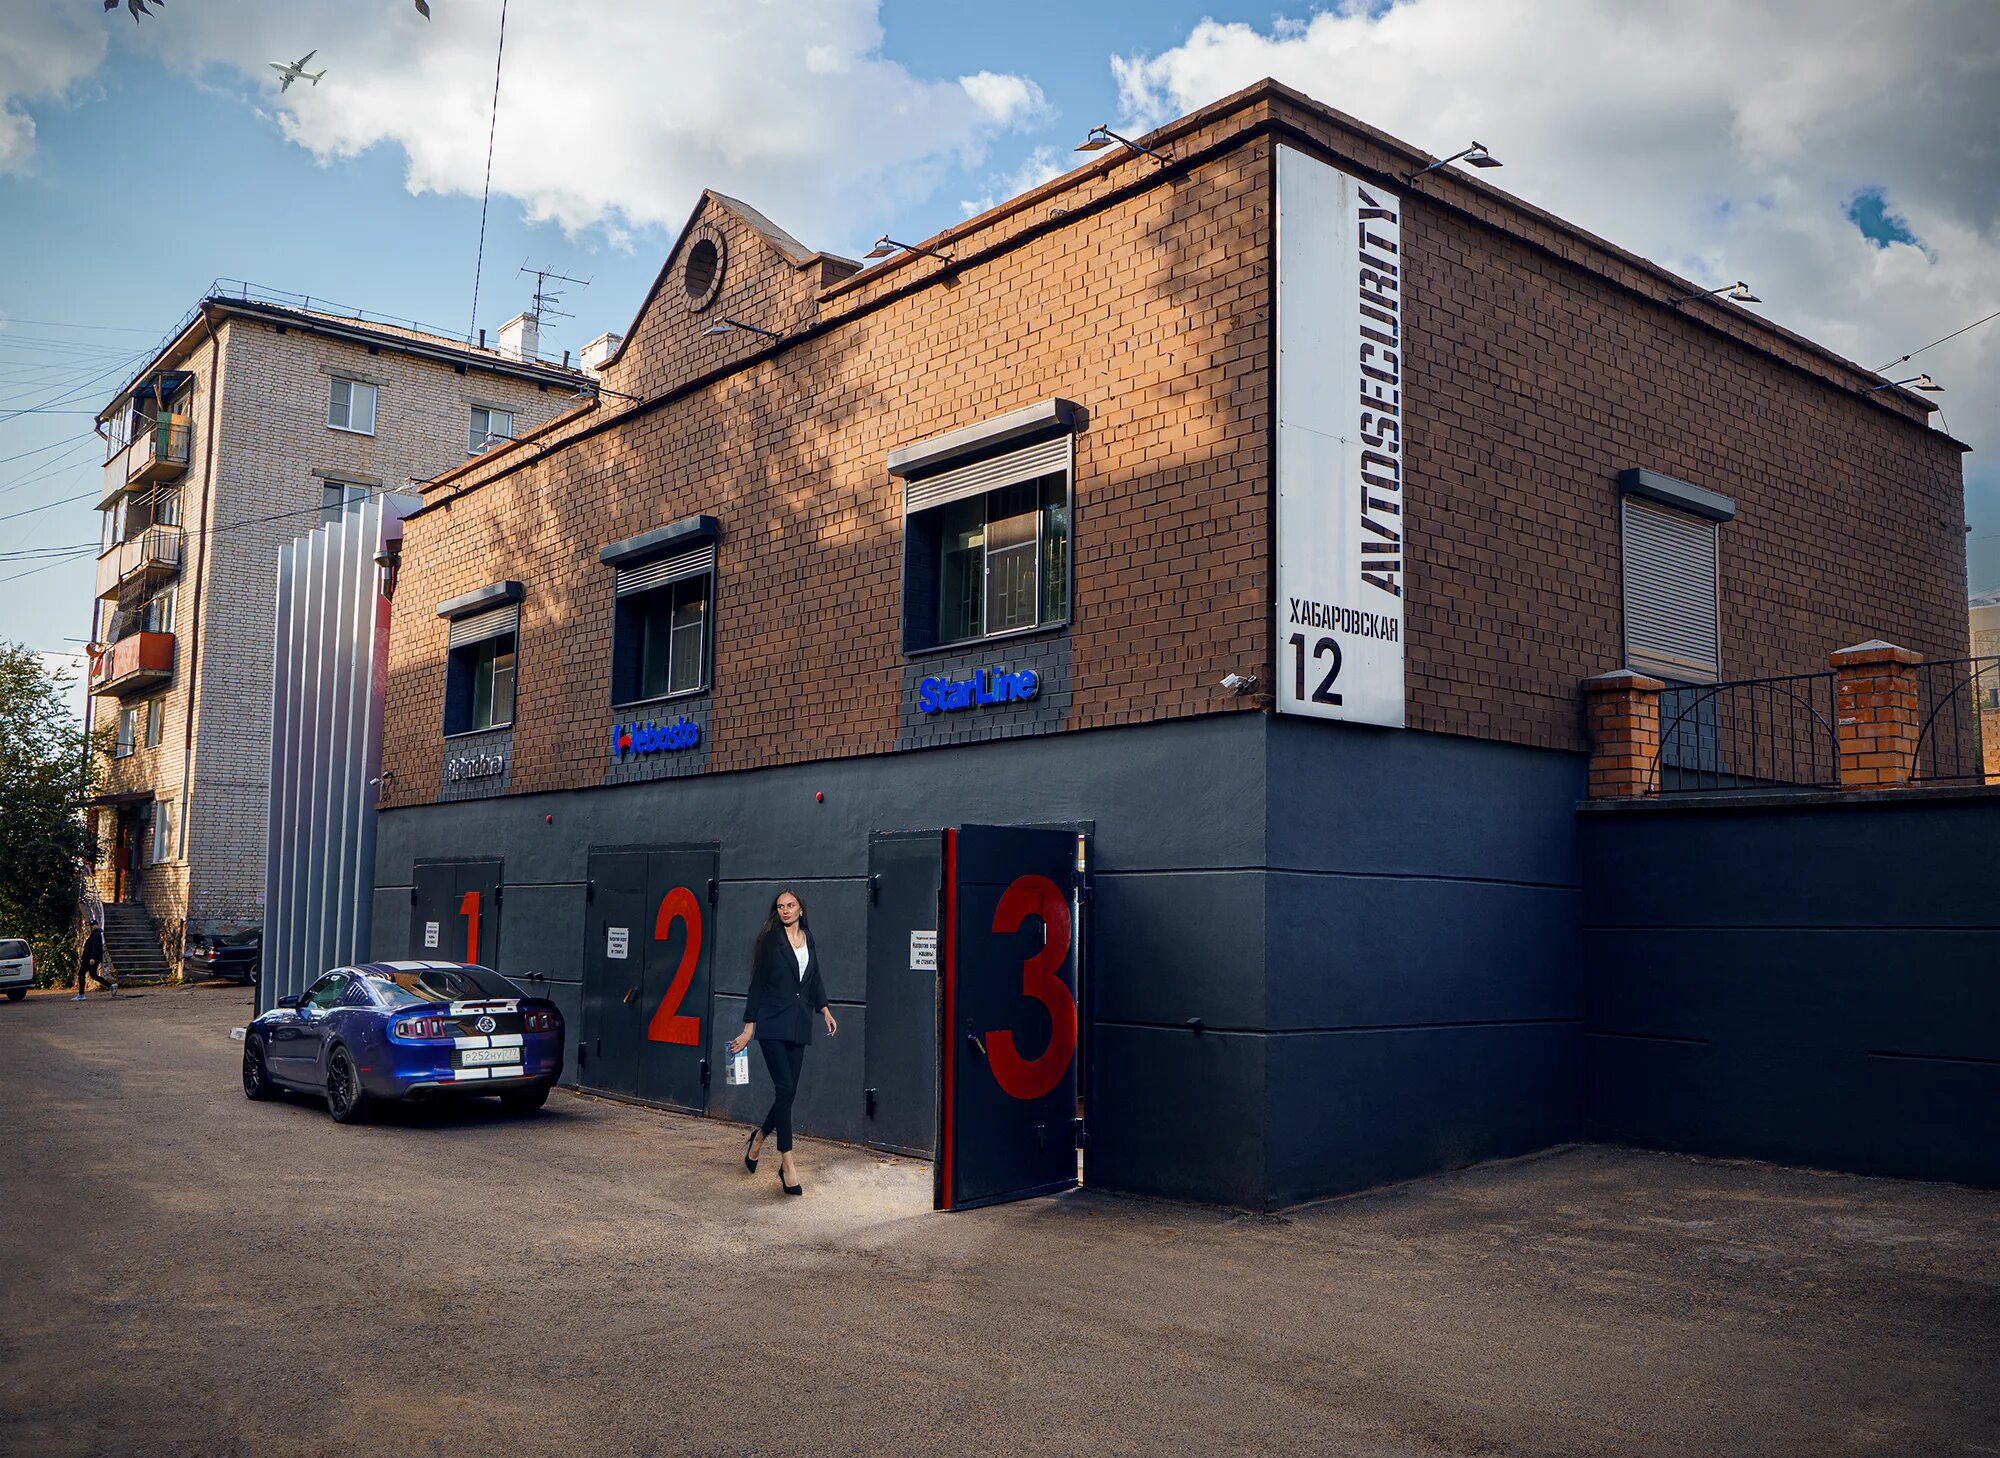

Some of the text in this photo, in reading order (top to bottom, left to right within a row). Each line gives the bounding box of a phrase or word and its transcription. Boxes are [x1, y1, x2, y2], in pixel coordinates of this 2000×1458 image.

[1358, 186, 1401, 598] AVTOSECURITY
[1289, 597, 1399, 643] ХАБАРОВСКАЯ
[919, 665, 1039, 715] StarLine
[1288, 632, 1343, 707] 12
[459, 891, 480, 965] 1
[648, 886, 703, 1047] 2
[985, 874, 1078, 1100] 3
